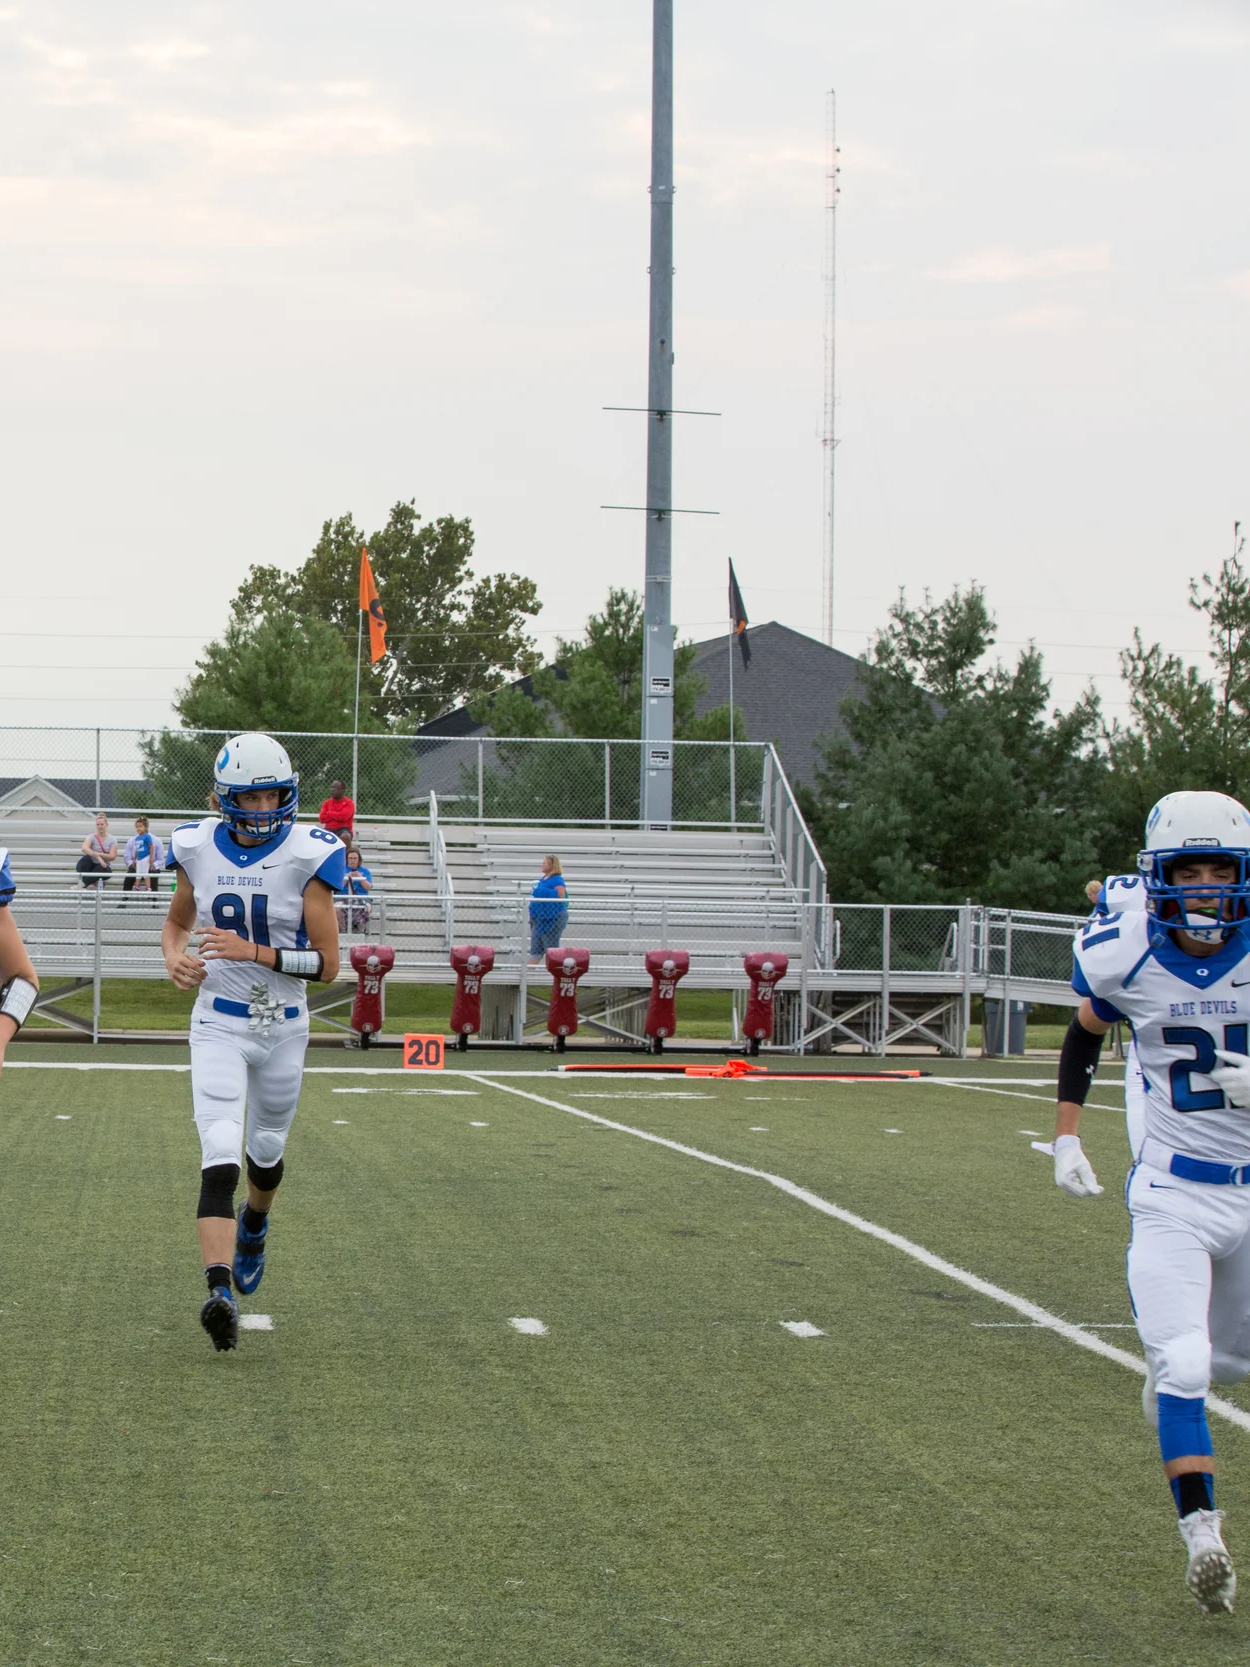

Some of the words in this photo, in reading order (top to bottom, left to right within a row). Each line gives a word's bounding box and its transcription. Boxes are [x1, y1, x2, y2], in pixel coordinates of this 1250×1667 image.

[1185, 838, 1218, 847] Riddell
[217, 875, 235, 886] BLUE
[238, 876, 263, 887] DEVILS
[211, 893, 271, 947] 81
[363, 980, 379, 994] 73
[463, 980, 479, 994] 73
[559, 983, 575, 997] 73
[658, 985, 674, 999] 73
[757, 986, 773, 1000] 73
[1170, 1001, 1196, 1017] BLUE
[1200, 1000, 1237, 1015] DEVILS
[408, 1039, 440, 1066] 20
